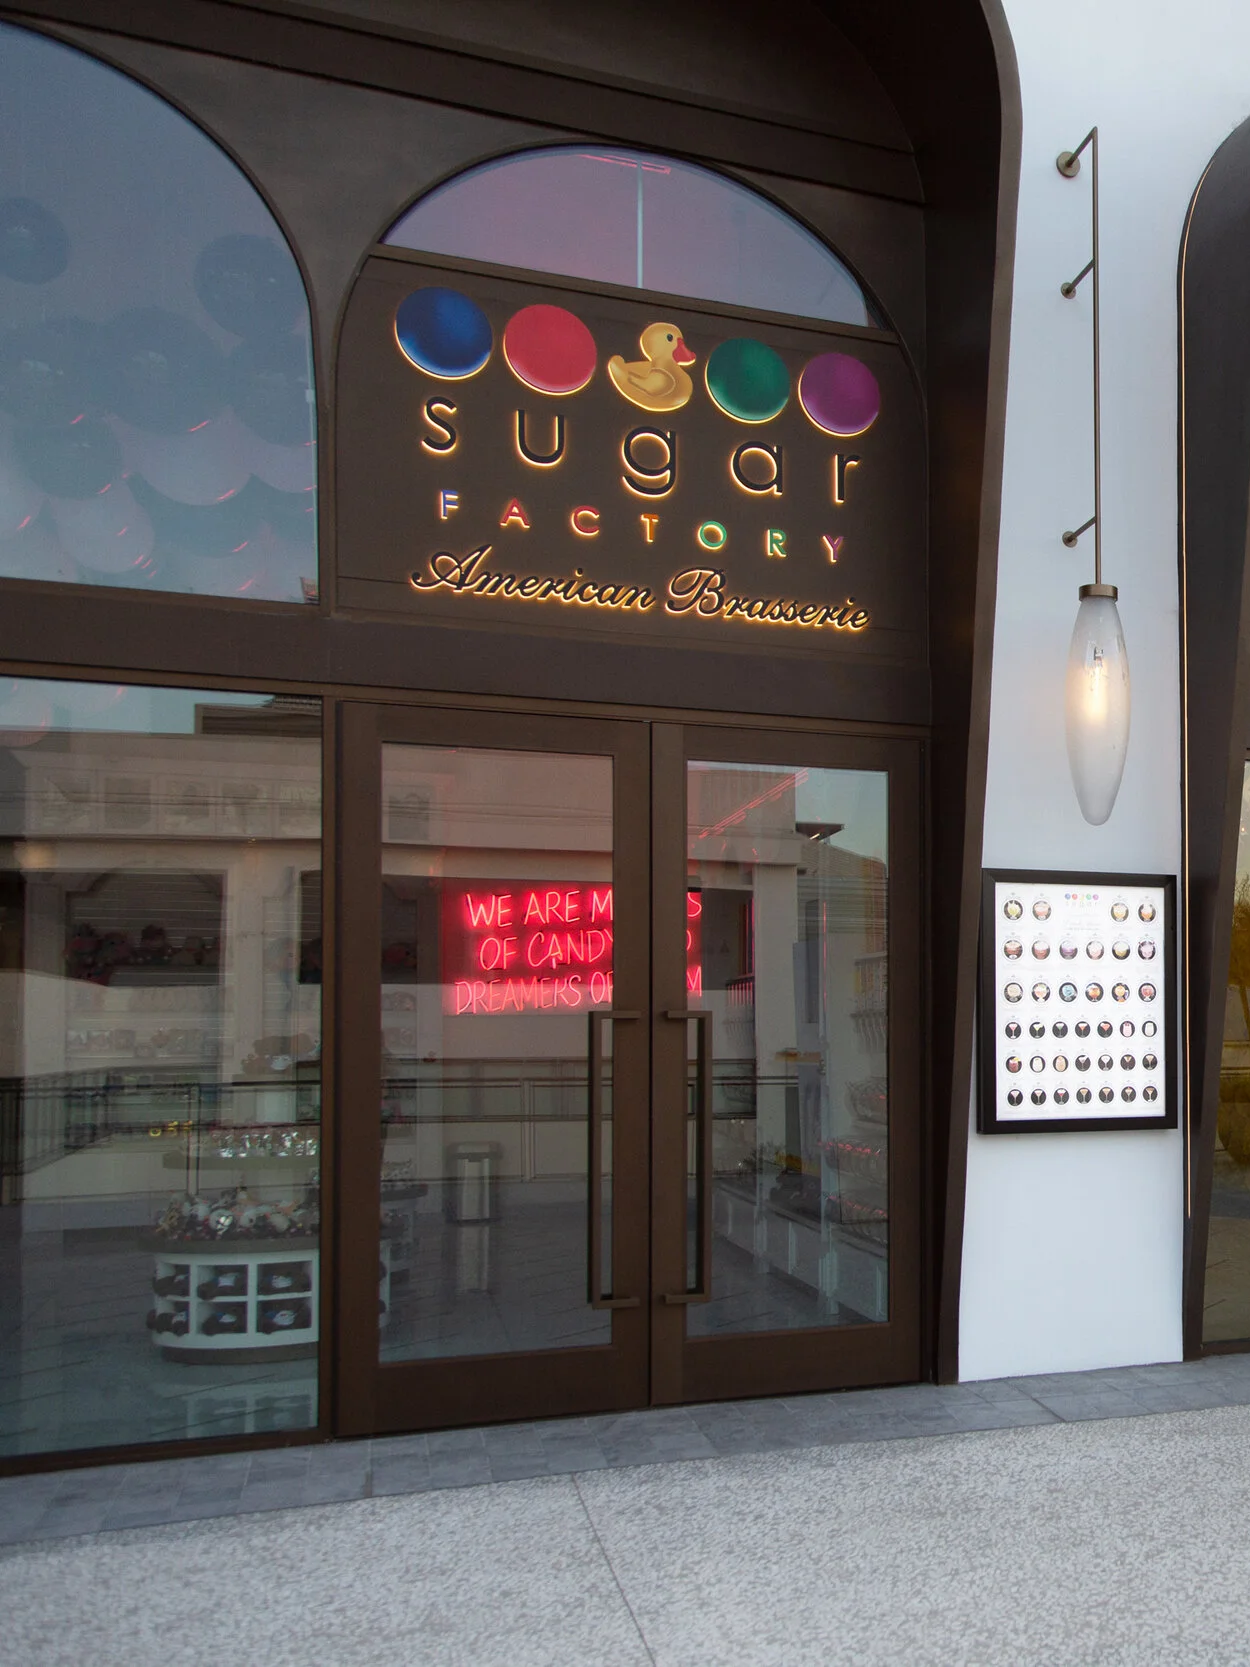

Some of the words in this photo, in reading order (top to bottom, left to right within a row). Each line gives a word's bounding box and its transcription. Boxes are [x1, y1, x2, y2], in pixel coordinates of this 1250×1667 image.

[438, 489, 845, 563] FACTORY
[409, 544, 656, 611] American
[665, 566, 871, 632] Brasserie
[466, 893, 513, 928] WE
[524, 890, 580, 924] ARE
[479, 936, 518, 970] OF
